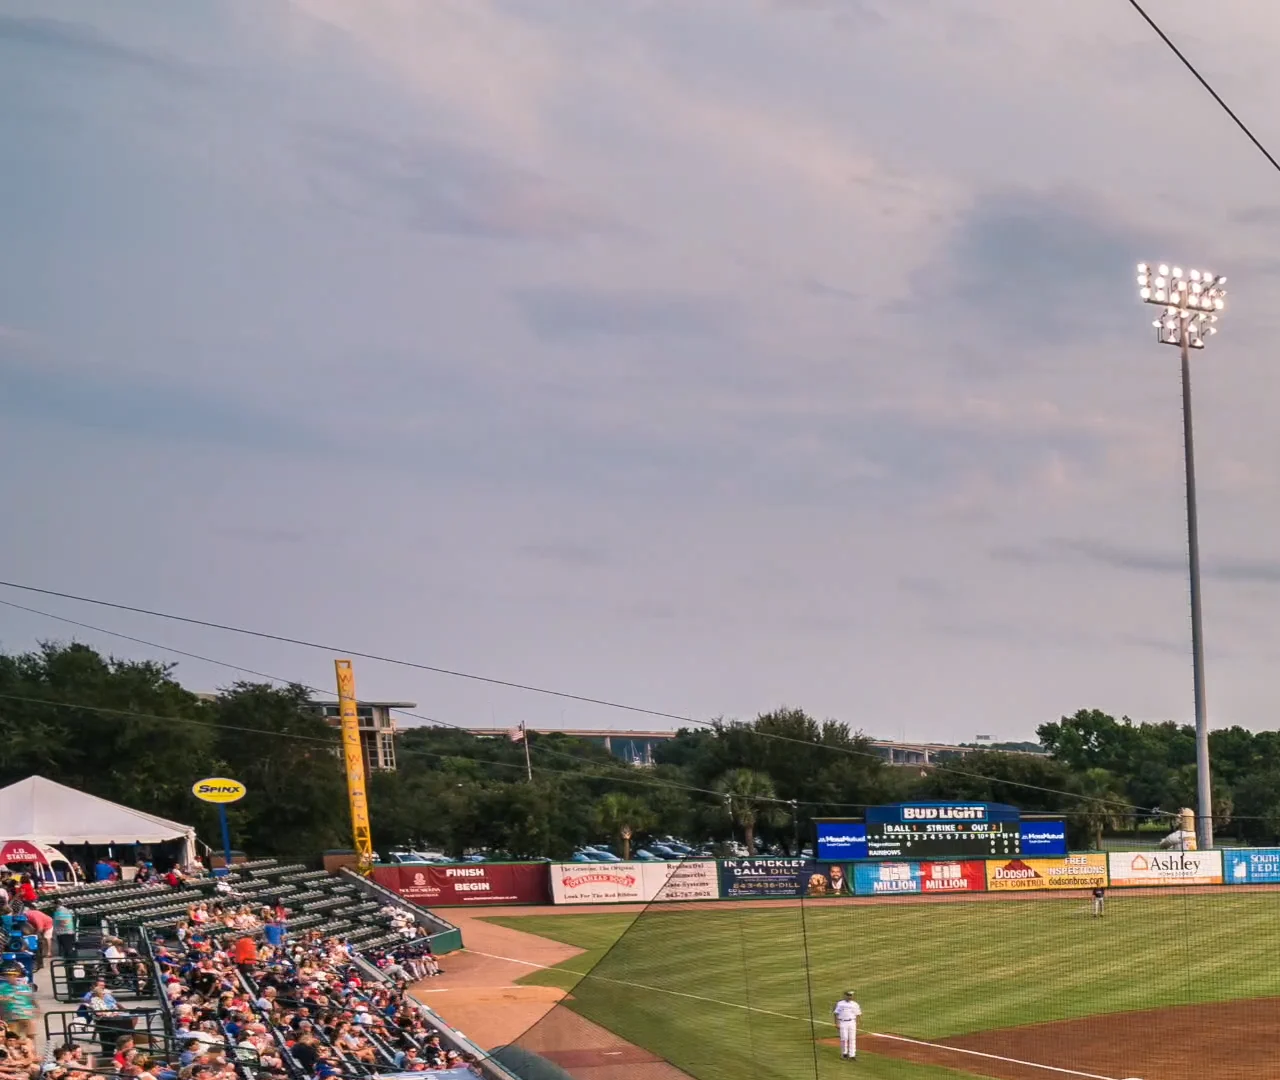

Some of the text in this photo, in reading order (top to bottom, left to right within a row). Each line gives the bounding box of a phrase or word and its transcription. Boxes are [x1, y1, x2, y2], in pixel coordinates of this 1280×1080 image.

[198, 784, 240, 794] SPINX
[903, 806, 984, 819] BUD LIGHT
[886, 824, 911, 832] BALL
[926, 824, 956, 832] STRIKE
[6, 853, 37, 861] STATION
[1064, 857, 1087, 865] FREE
[1250, 854, 1279, 863] SOUTH
[1150, 855, 1201, 874] Ashley
[445, 868, 485, 877] FINISH
[733, 868, 766, 876] CALL
[995, 867, 1035, 879] DODSON
[873, 880, 917, 891] MILLION
[926, 879, 968, 889] MILLION
[989, 879, 1046, 888] PEST CONTROL
[1048, 877, 1104, 886] dodsonbros.com
[454, 882, 490, 891] BEGIN
